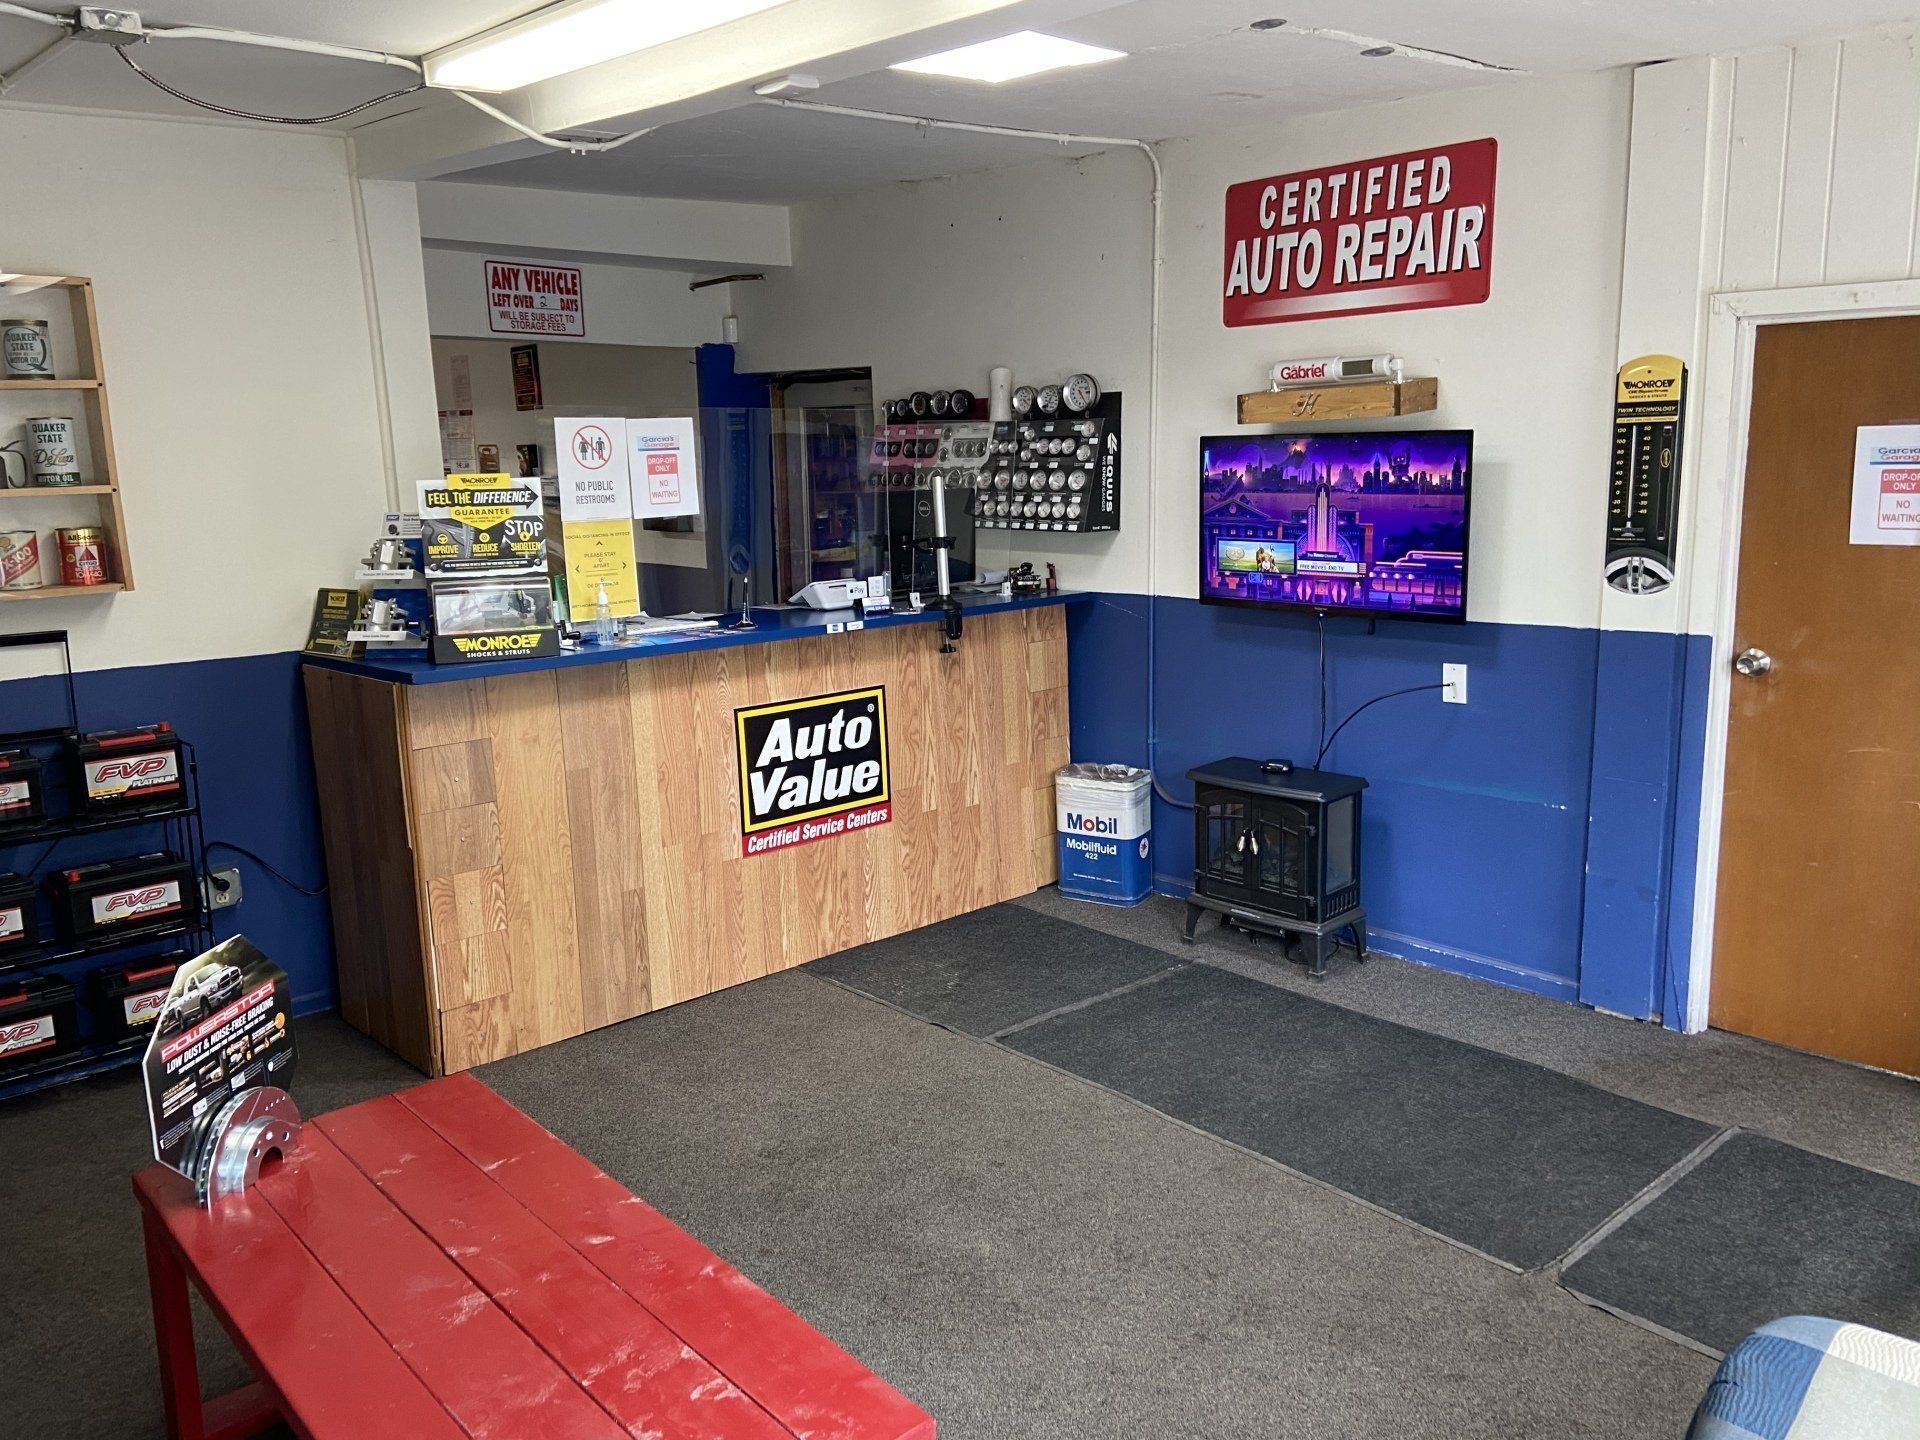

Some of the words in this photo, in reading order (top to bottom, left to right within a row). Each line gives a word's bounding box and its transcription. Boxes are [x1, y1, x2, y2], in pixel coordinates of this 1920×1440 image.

[1259, 155, 1451, 230] CERTIFIED
[1225, 228, 1322, 297] AUTO
[1333, 203, 1485, 284] REPAIR
[492, 266, 520, 291] ANY
[523, 269, 578, 295] VEHICLE
[492, 293, 511, 307] LEFT
[513, 294, 534, 309] OVER
[540, 296, 548, 307] 2
[560, 298, 578, 312] DAYS
[499, 310, 518, 320] WILL
[519, 312, 529, 320] BE
[531, 313, 563, 323] SUBJECT
[565, 314, 574, 323] TO
[511, 321, 546, 330] STORAGE
[548, 323, 566, 332] FEES
[6, 332, 37, 342] QUAKER
[11, 343, 34, 351] STATE
[1280, 363, 1327, 380] Gabriel
[1627, 380, 1671, 389] MONROE
[32, 423, 66, 433] QUAKER
[37, 433, 63, 443] STATE
[648, 456, 676, 465] DROP-OFF
[1102, 456, 1106, 465] WE
[575, 482, 586, 491] NO
[587, 481, 614, 491] PUBLIC
[1893, 482, 1916, 490] ONLY
[428, 493, 452, 505] FEEL
[452, 492, 471, 504] THE
[576, 495, 615, 505] RESTROOMS
[651, 490, 678, 499] WAITING
[1896, 500, 1910, 509] NO
[455, 508, 510, 516] GUARANTEE
[504, 519, 543, 536] STOP
[428, 545, 459, 555] IMPROVE
[472, 543, 498, 552] REDUCE
[511, 541, 541, 551] SHORTEN
[3, 546, 32, 570] X-100
[458, 634, 536, 652] MONROE
[755, 708, 872, 768] Auto
[95, 758, 167, 783] FVP
[132, 774, 176, 788] PLATINUM
[750, 758, 880, 816] Value
[1067, 812, 1117, 834] Mobil
[748, 826, 799, 853] Certified
[802, 818, 844, 840] Service
[847, 809, 887, 828] Centers
[1066, 837, 1117, 855] Mobilfluid
[1084, 852, 1098, 860] 422
[105, 887, 165, 912] FVP
[135, 902, 168, 913] PLATINUM
[132, 992, 169, 1013] FV
[166, 1055, 183, 1074] LOW
[184, 1042, 203, 1066] DUST
[203, 1039, 210, 1050] &
[211, 1018, 247, 1047] NOISE-FREE
[247, 996, 274, 1021] BRAKING
